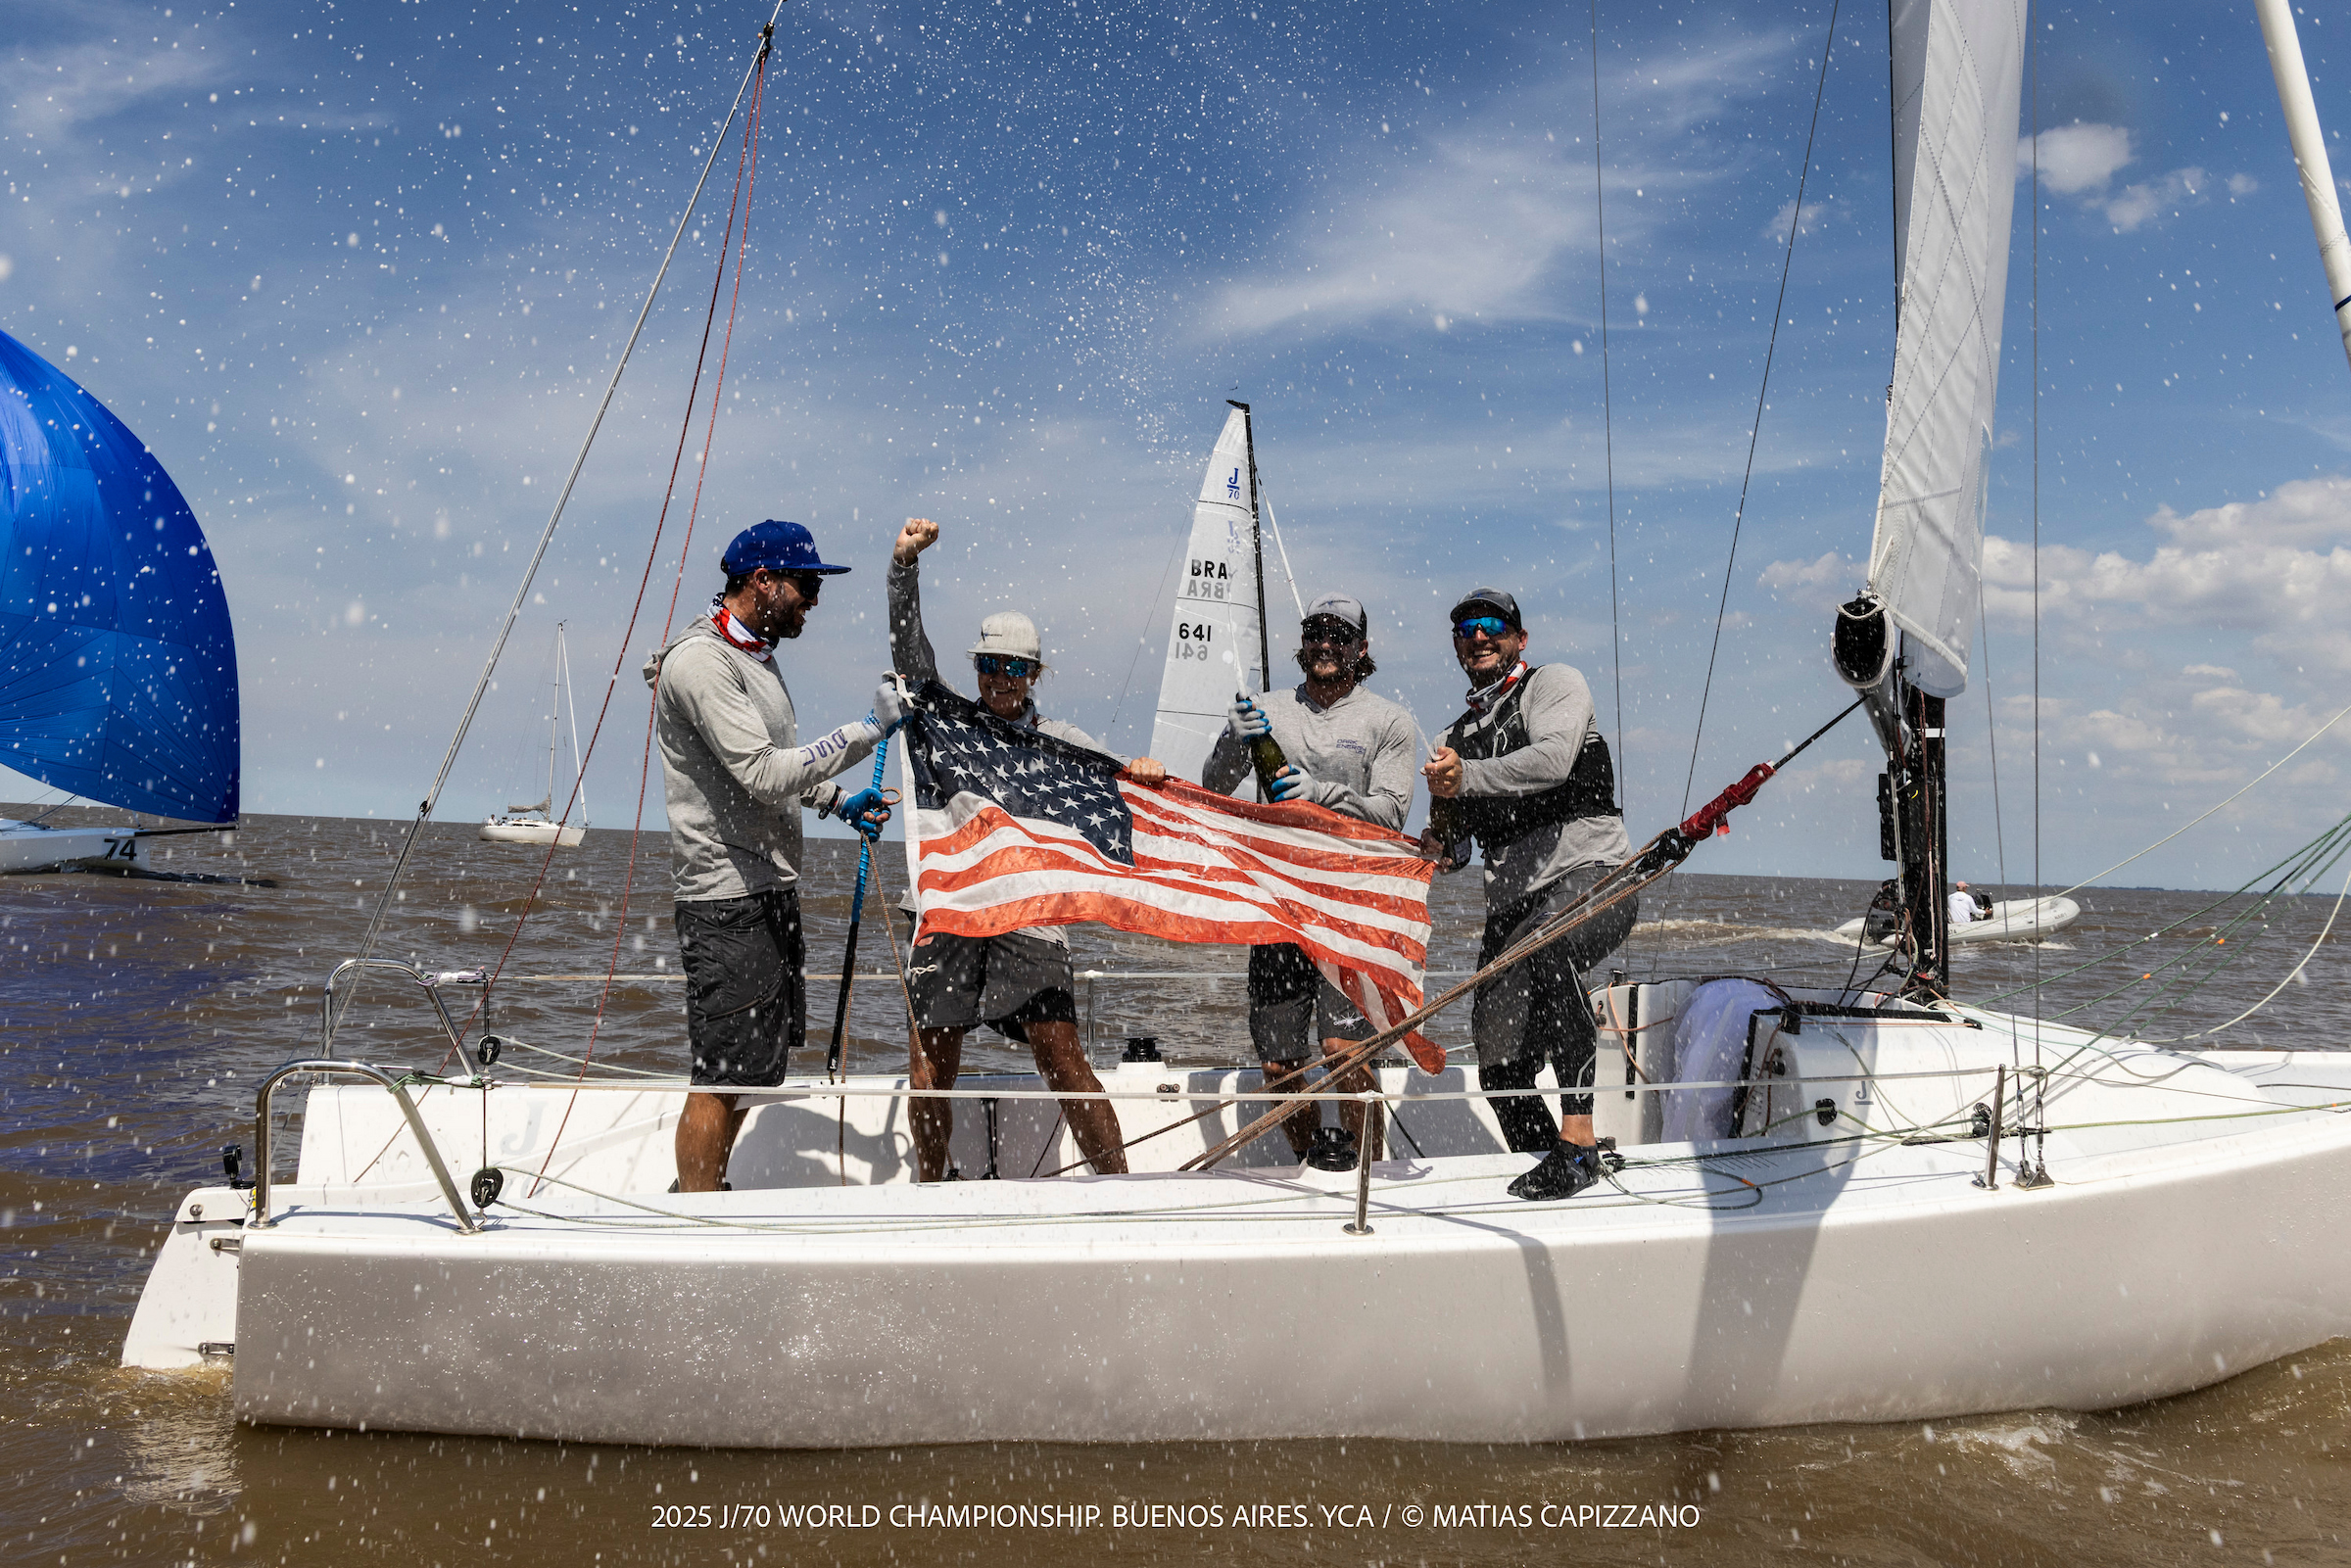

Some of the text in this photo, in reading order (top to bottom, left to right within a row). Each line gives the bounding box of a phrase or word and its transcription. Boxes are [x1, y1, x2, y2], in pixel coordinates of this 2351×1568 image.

[1228, 467, 1239, 485] J
[1228, 489, 1240, 499] 70
[1191, 559, 1228, 580] BRA
[1178, 622, 1212, 642] 641
[799, 728, 848, 767] USA
[104, 838, 137, 861] 74
[500, 1100, 549, 1156] J
